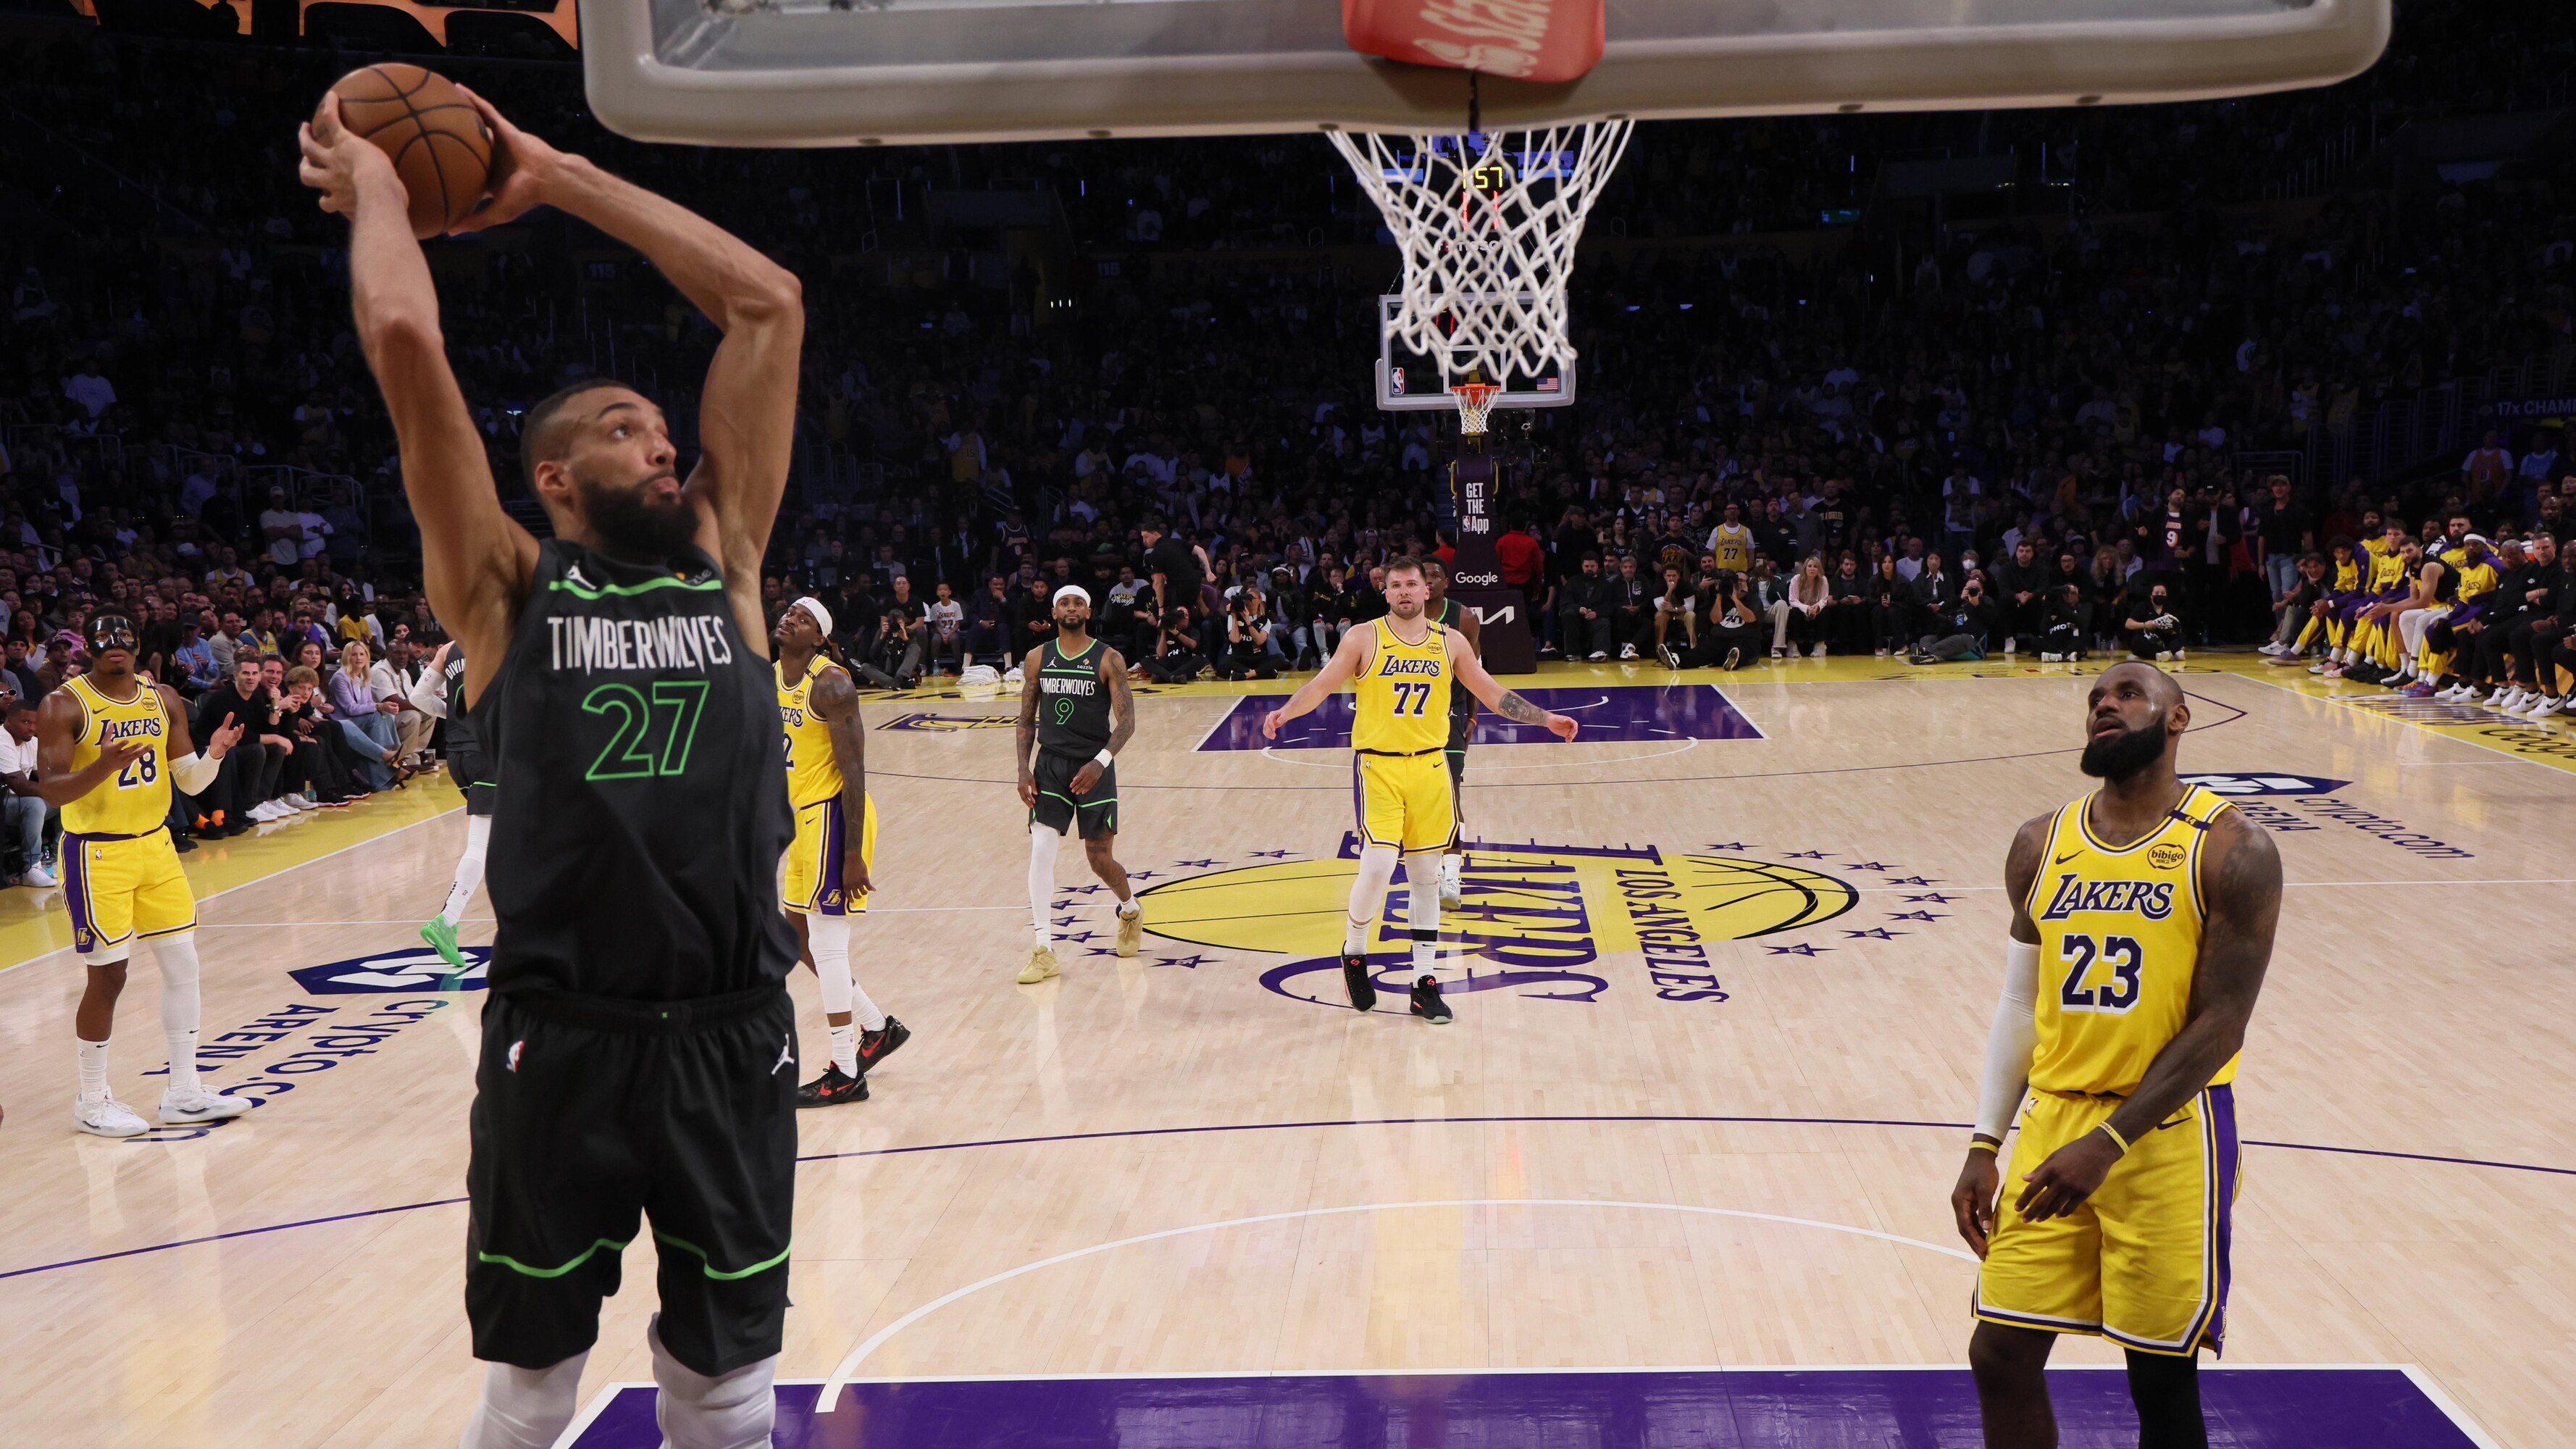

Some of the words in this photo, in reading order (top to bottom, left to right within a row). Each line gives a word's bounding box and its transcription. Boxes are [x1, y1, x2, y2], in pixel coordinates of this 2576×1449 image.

[2497, 401, 2520, 416] 17x
[2523, 398, 2576, 415] CHAM
[1466, 483, 1484, 498] GET
[1466, 499, 1484, 514] THE
[1471, 516, 1489, 534] App
[1723, 548, 1739, 560] 77
[1455, 572, 1498, 585] Google
[1378, 655, 1440, 677] LAKERS
[1040, 677, 1096, 698] TIMBERWOLVES
[1392, 682, 1431, 717] 77
[1055, 698, 1074, 724] 9
[582, 680, 710, 781] 27
[2185, 816, 2196, 825] 44
[2294, 798, 2475, 859] crypto.com
[2151, 849, 2184, 862] bibigo
[1615, 869, 1682, 899] LOS
[2040, 872, 2175, 921] LAKERS
[1626, 901, 1730, 1003] ANGELES
[2059, 932, 2144, 1015] 23
